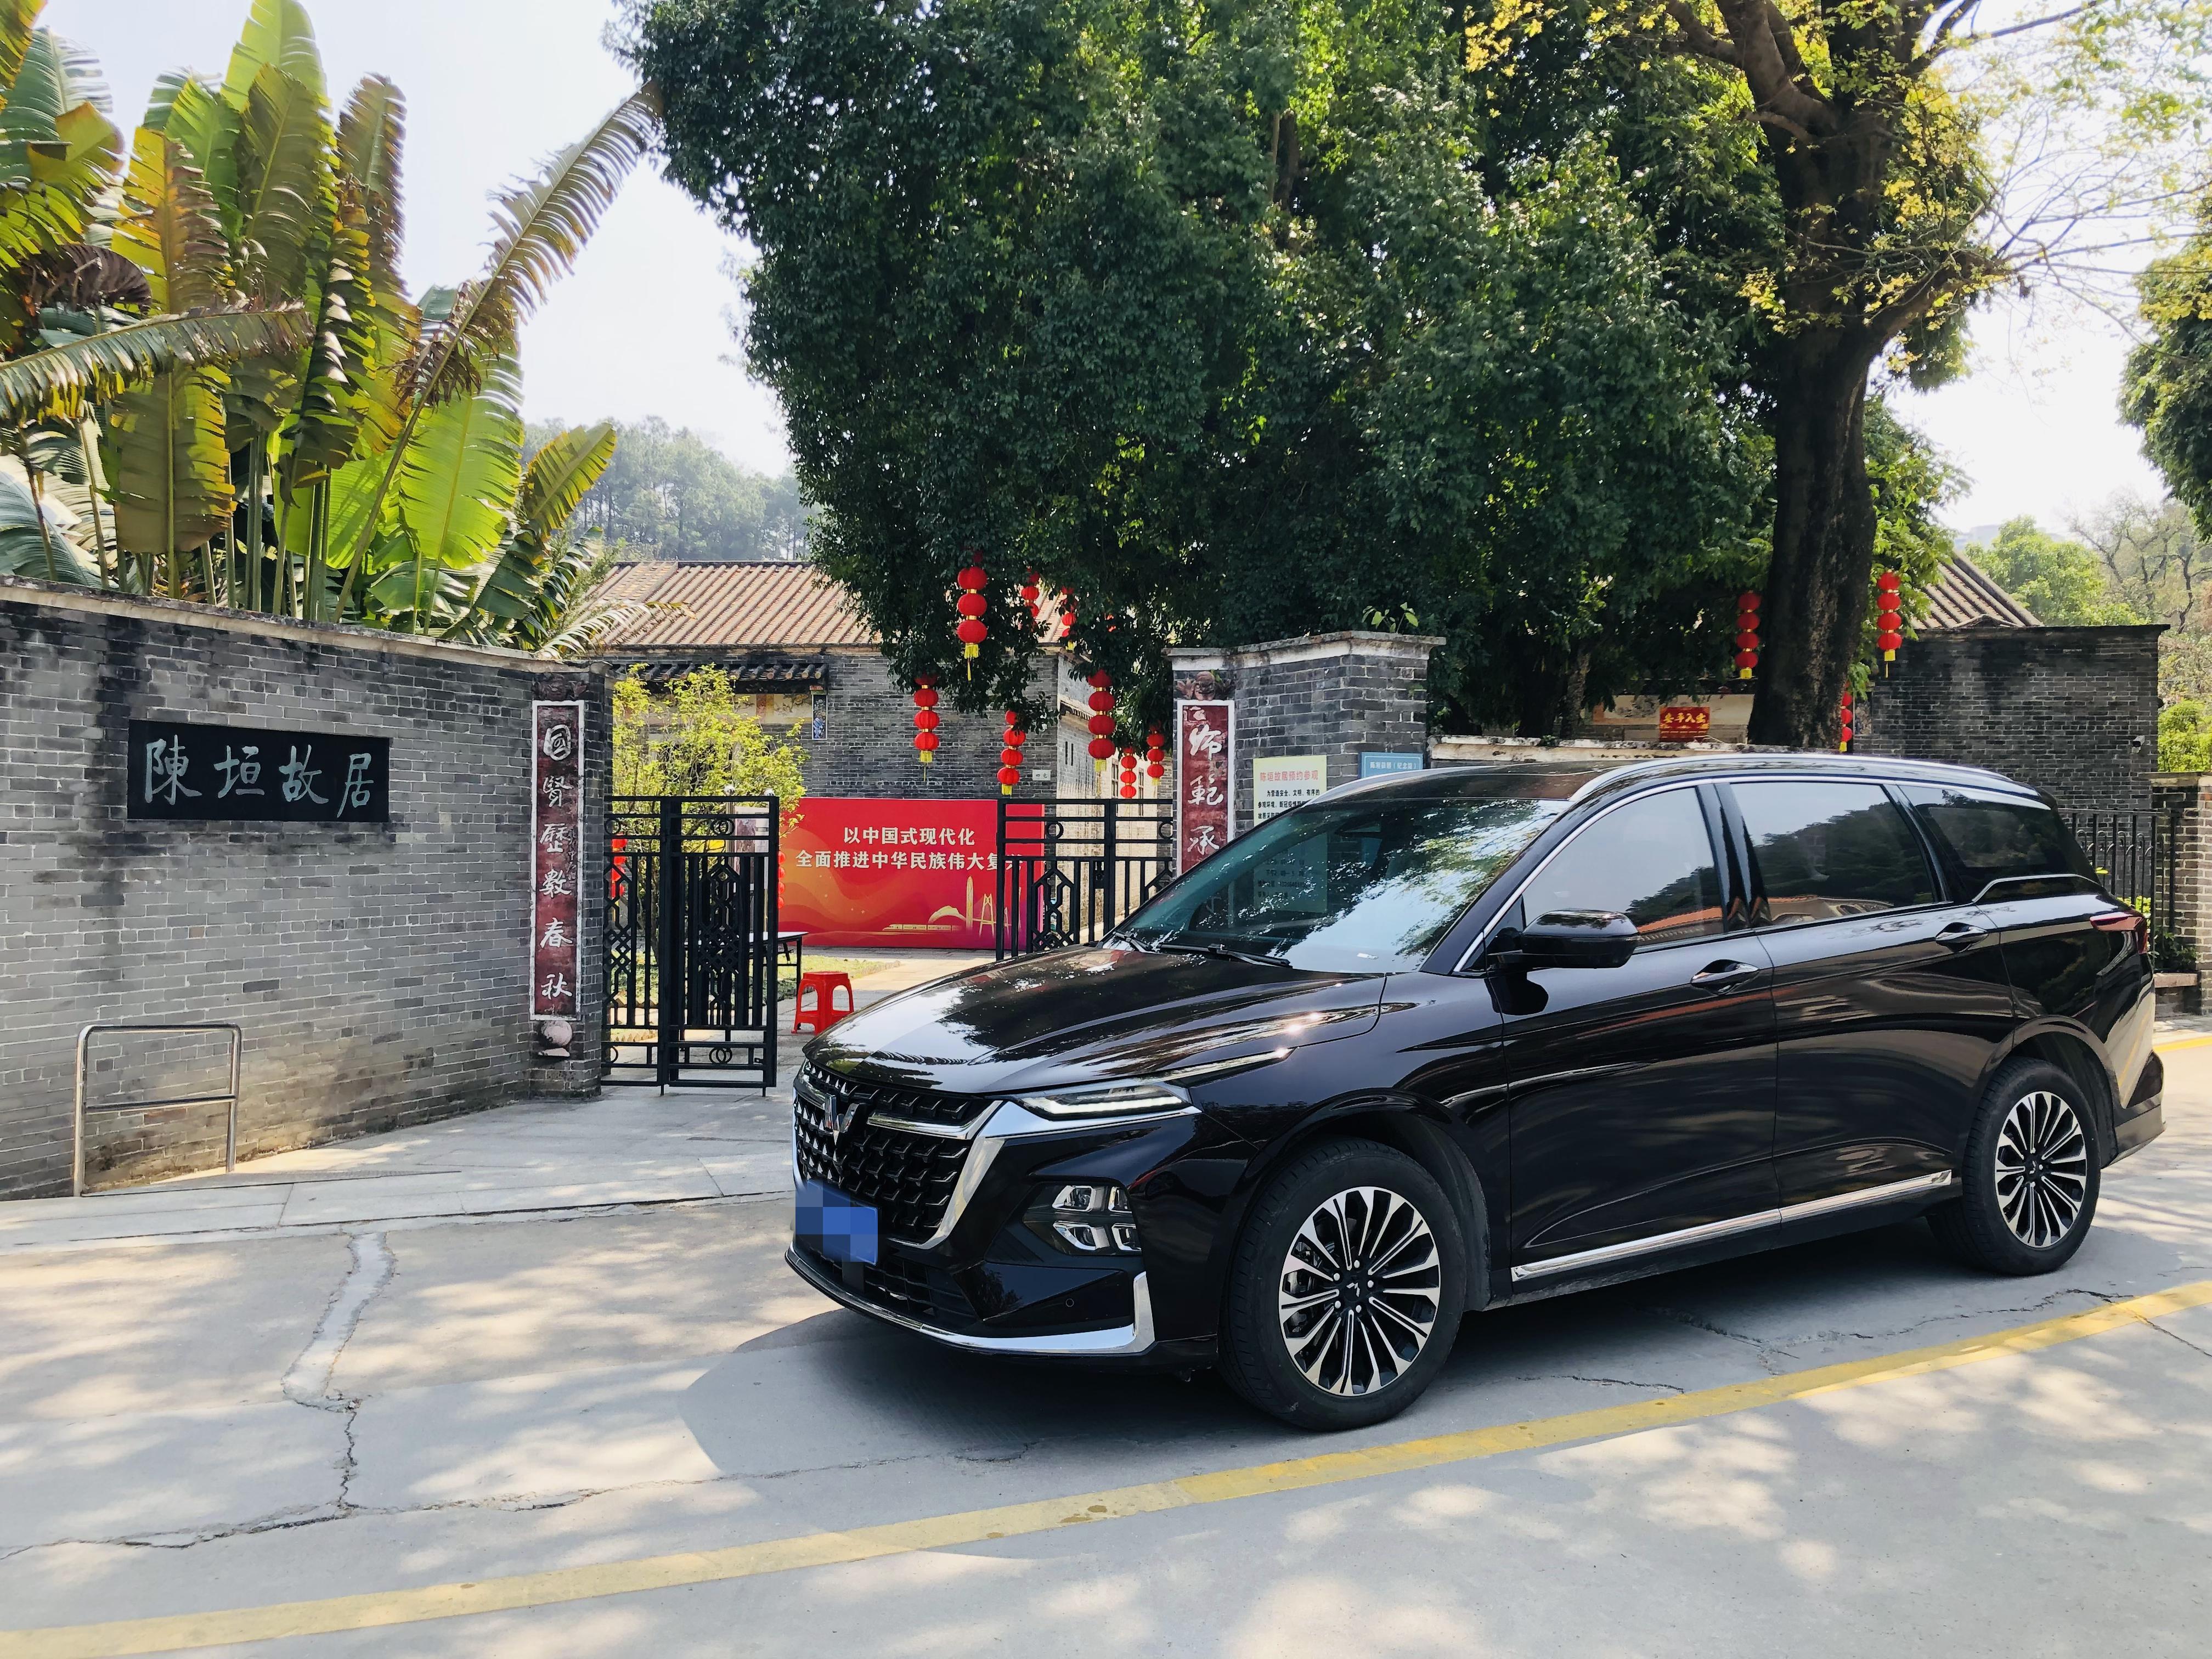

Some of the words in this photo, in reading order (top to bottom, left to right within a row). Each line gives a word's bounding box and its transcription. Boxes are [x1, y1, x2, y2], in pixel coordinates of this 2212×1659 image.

[144, 734, 374, 818] 陳垣故居
[1260, 770, 1318, 782] 陈垣故居预约参观
[844, 827, 975, 845] 以中国式现代化
